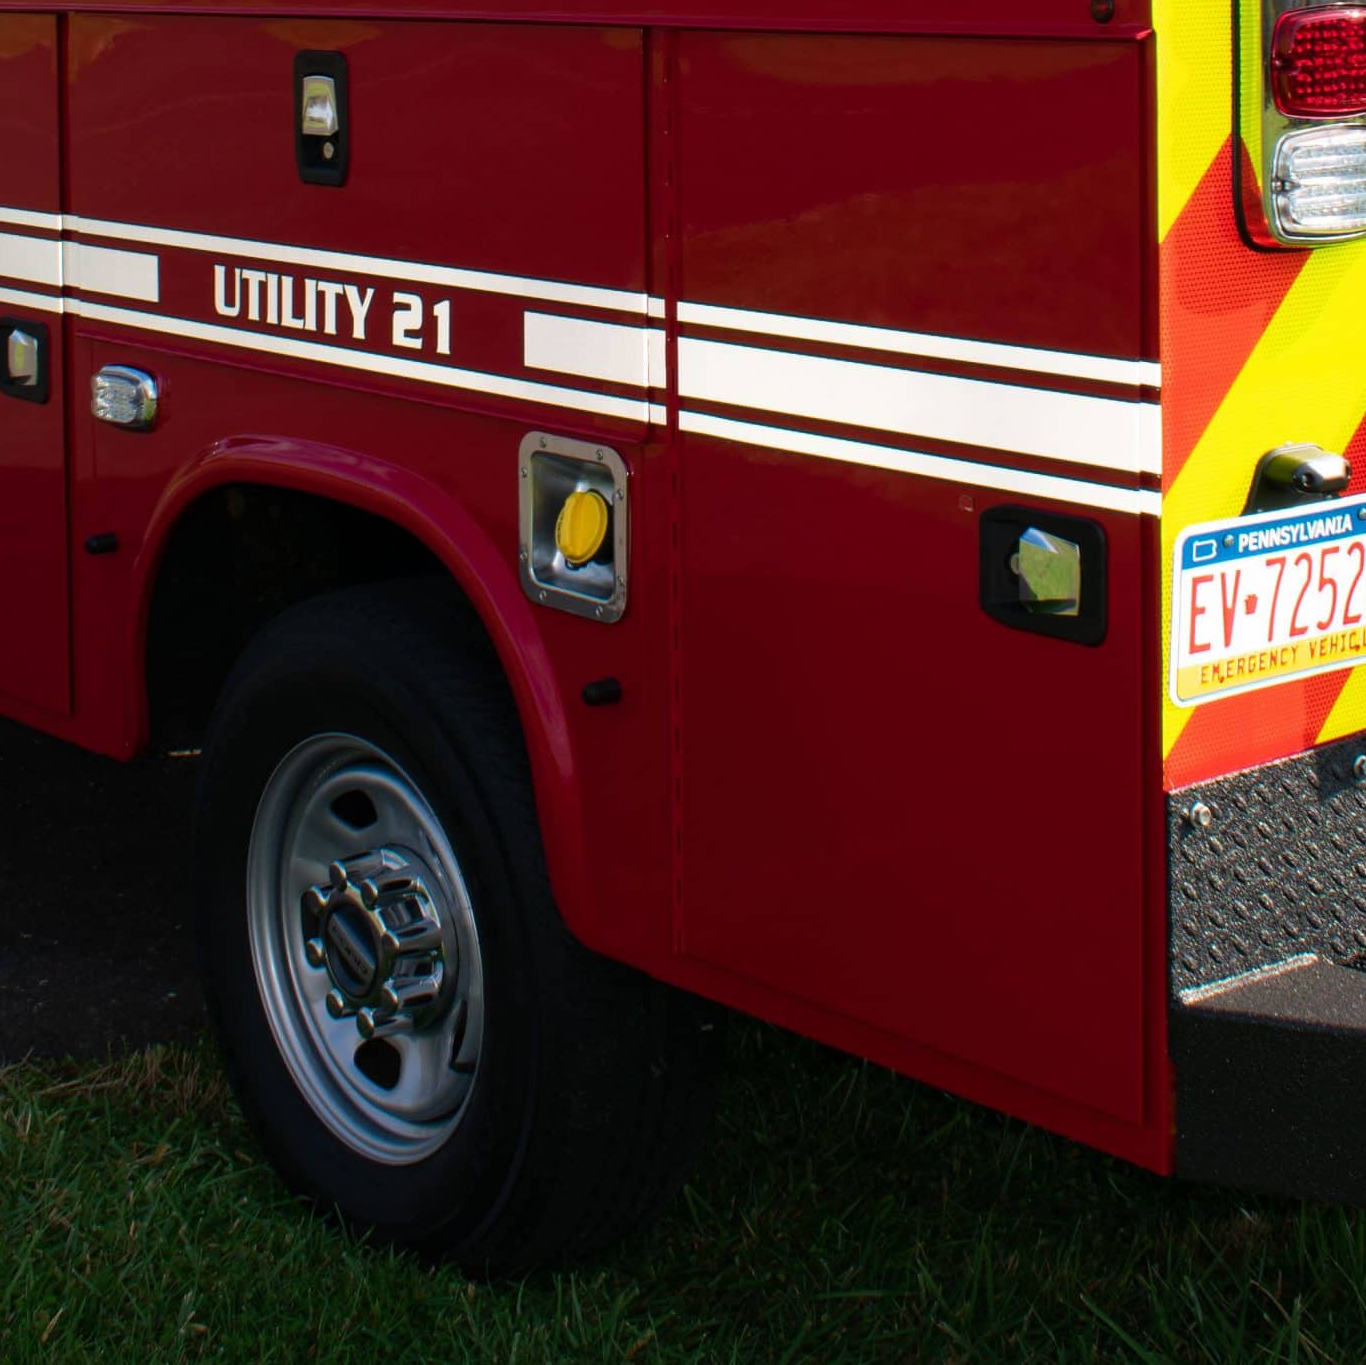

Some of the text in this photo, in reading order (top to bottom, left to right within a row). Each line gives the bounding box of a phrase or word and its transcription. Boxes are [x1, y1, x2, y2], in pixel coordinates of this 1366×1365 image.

[213, 264, 451, 355] UTILITY 21
[1238, 514, 1354, 553] PENNSYLVANIA
[1200, 642, 1300, 684] EMERGENCY
